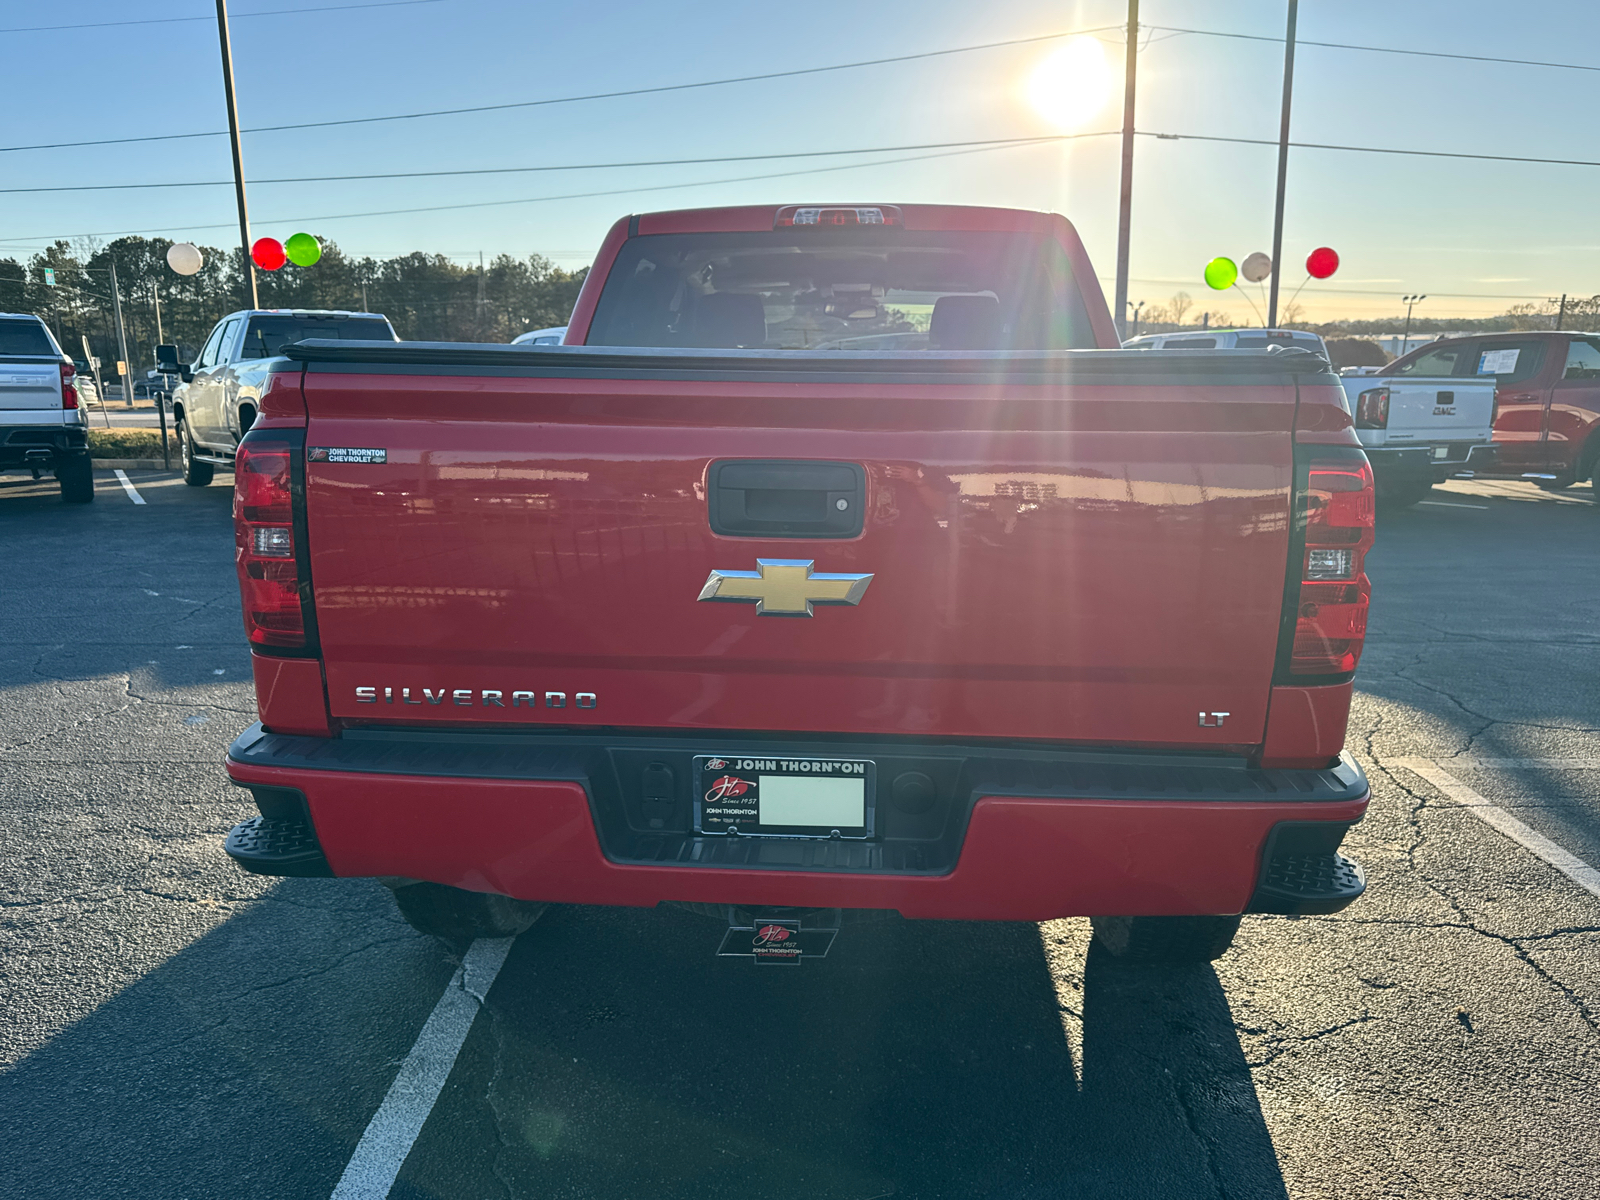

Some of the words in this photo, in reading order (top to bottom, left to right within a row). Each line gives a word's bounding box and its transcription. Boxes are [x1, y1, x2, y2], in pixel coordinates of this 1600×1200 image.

[1432, 407, 1456, 415] GMC
[355, 686, 597, 709] SILVERADO
[1199, 711, 1230, 727] LT
[735, 760, 777, 771] JOHN
